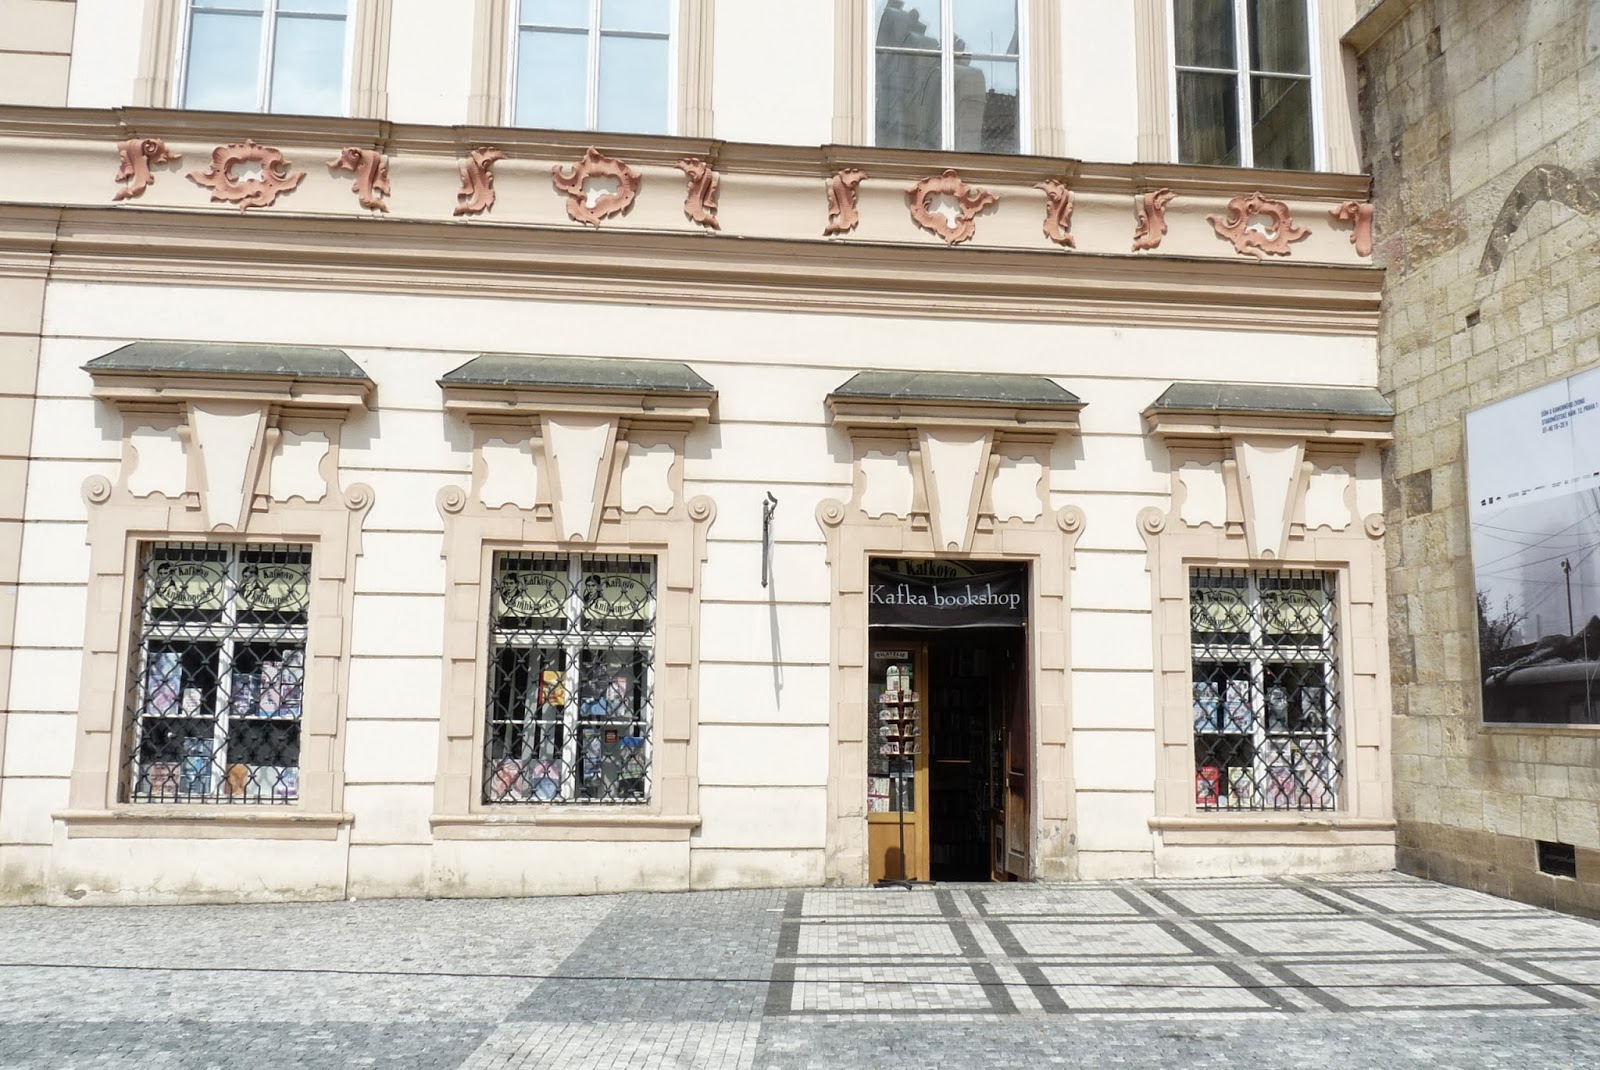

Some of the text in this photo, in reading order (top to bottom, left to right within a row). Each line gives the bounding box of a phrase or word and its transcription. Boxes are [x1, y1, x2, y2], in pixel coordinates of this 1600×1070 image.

[178, 564, 210, 578] Kafkvo
[869, 583, 1021, 609] Kafka bookshop
